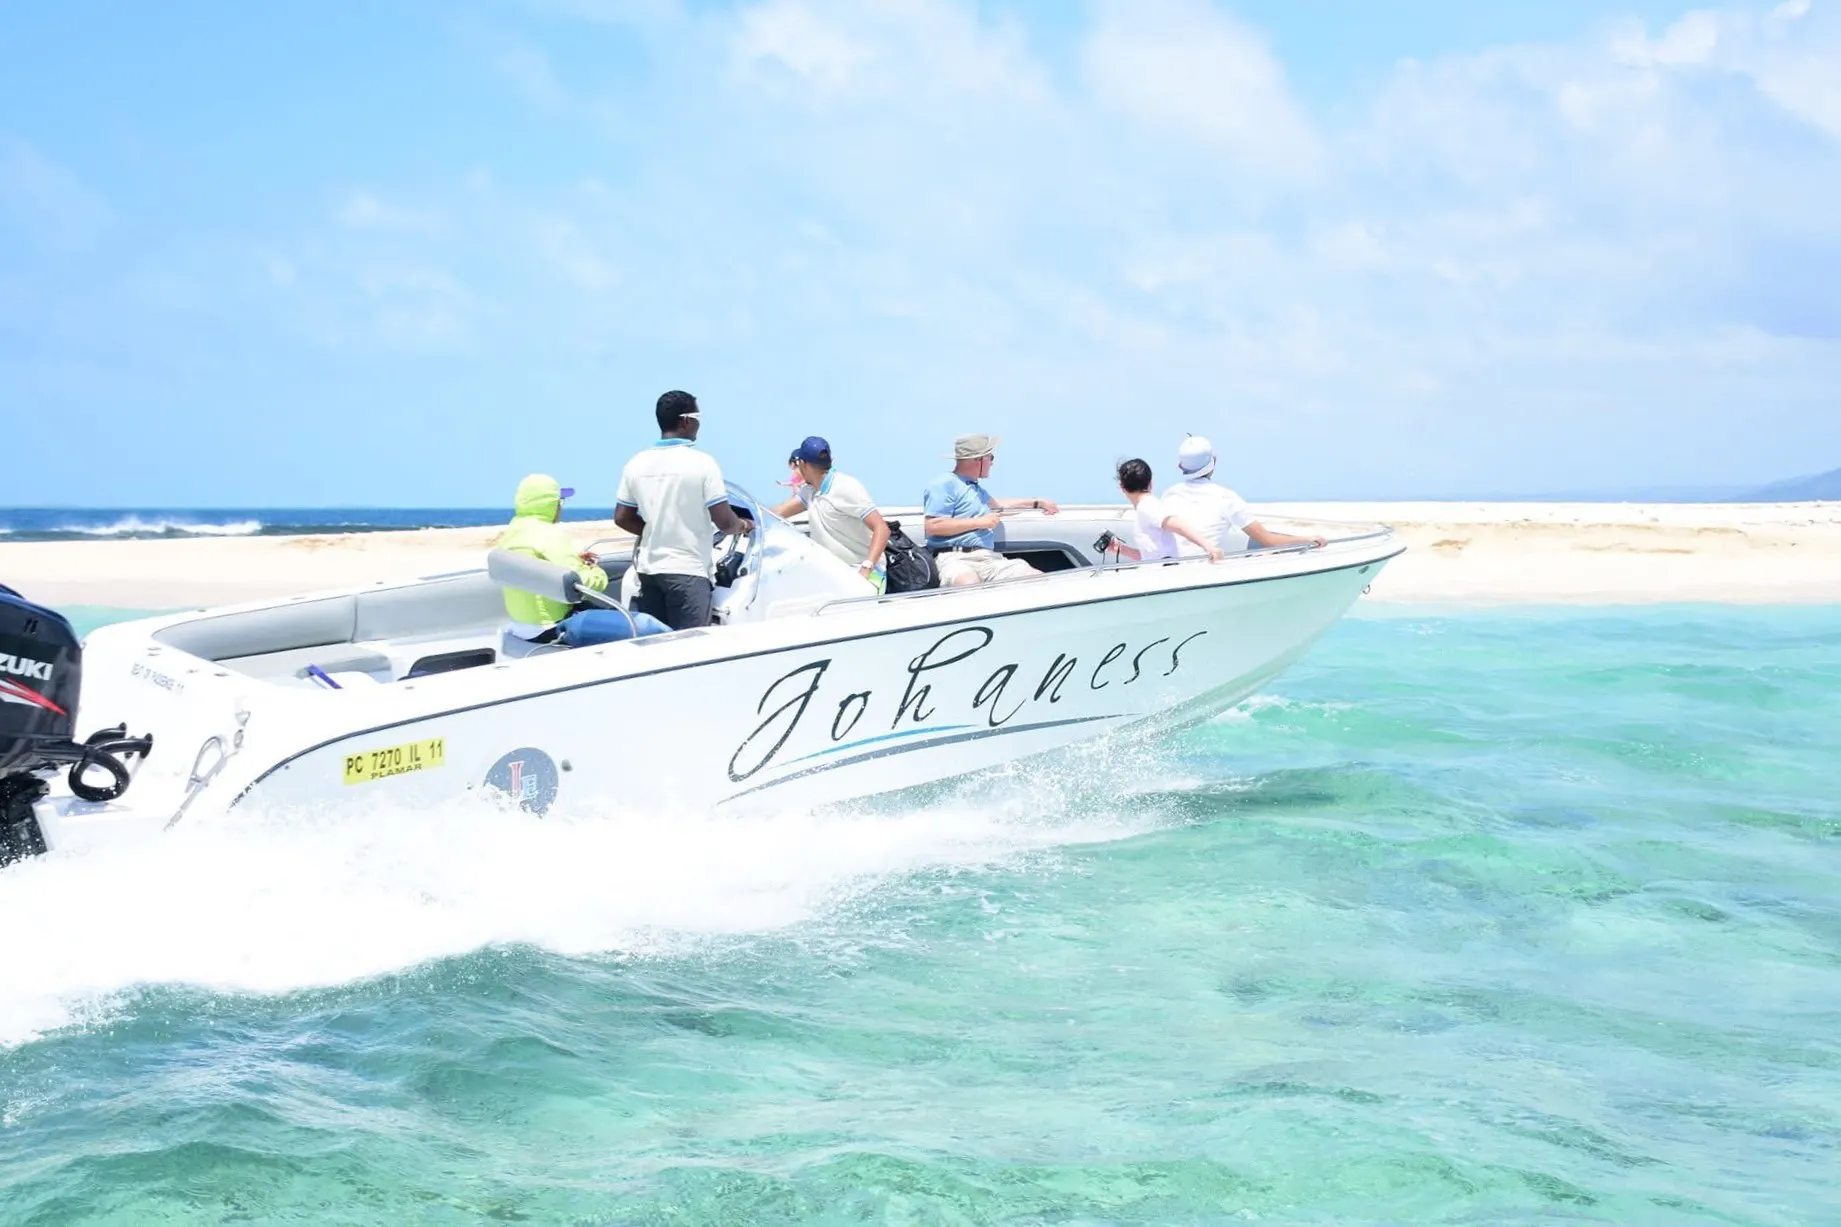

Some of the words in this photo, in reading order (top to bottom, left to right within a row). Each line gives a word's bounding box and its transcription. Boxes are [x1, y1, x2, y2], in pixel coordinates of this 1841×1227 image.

[346, 755, 363, 776] PC
[371, 747, 402, 770] 7270
[409, 744, 421, 763] IL
[429, 739, 442, 759] 11
[370, 763, 423, 780] PLAMAR
